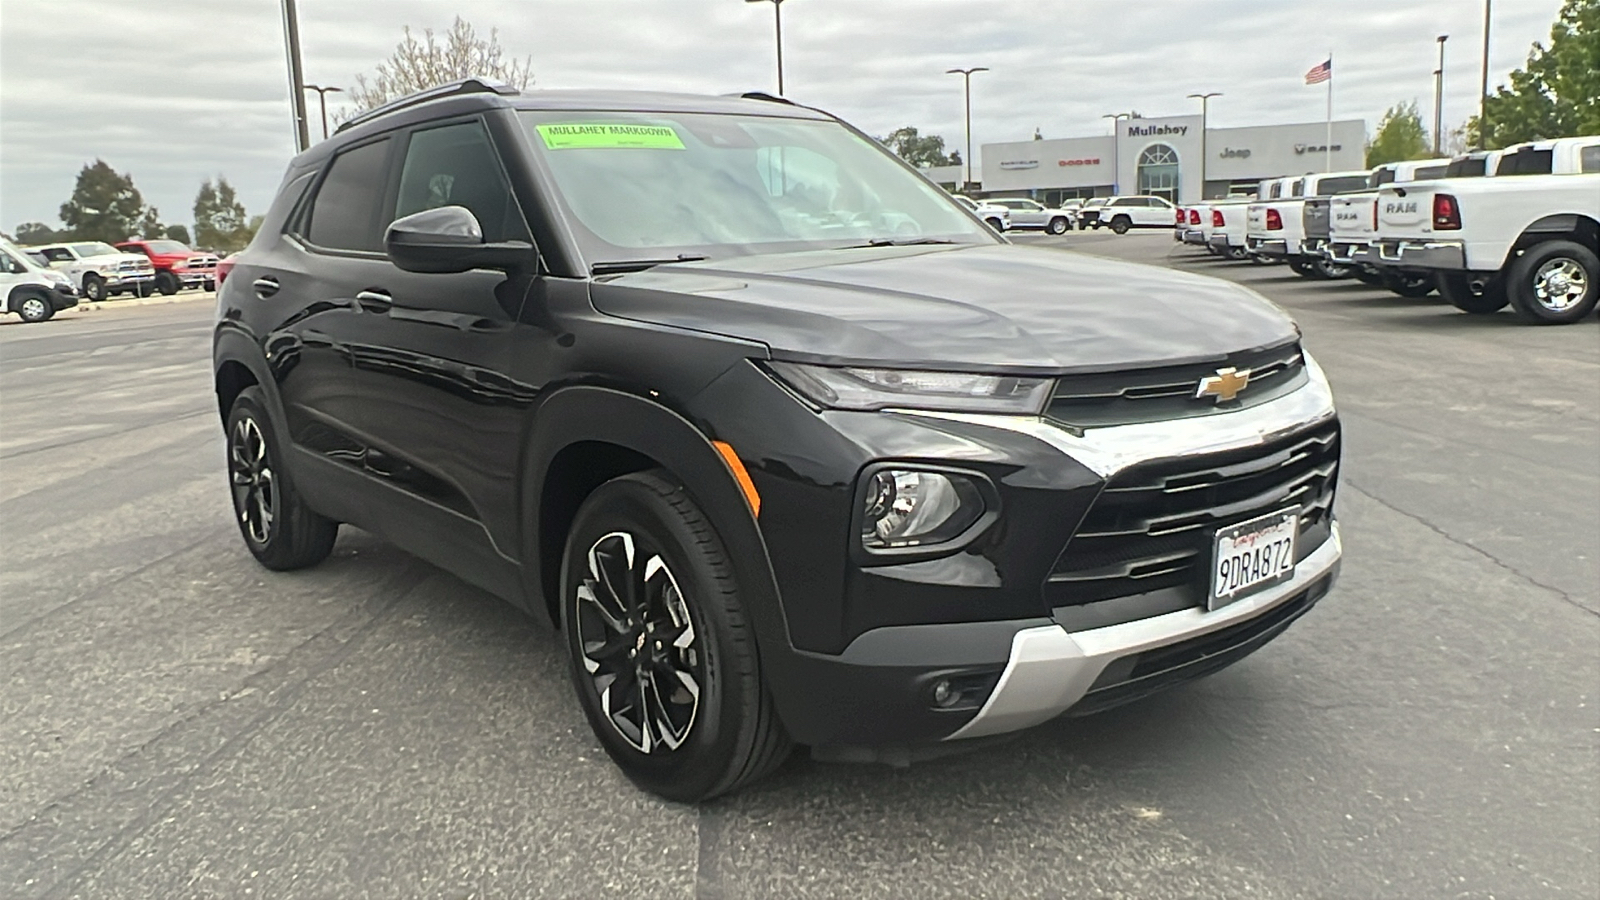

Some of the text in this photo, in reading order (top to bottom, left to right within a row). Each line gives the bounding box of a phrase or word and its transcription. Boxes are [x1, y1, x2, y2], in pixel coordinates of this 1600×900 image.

[548, 126, 672, 137] MULLAHEY MARKDOWN
[1128, 124, 1187, 137] Mullahey
[1219, 147, 1251, 159] Jeep
[1058, 159, 1100, 167] DODGE
[1386, 202, 1417, 213] RAM
[1218, 537, 1291, 594] 9DRA872
